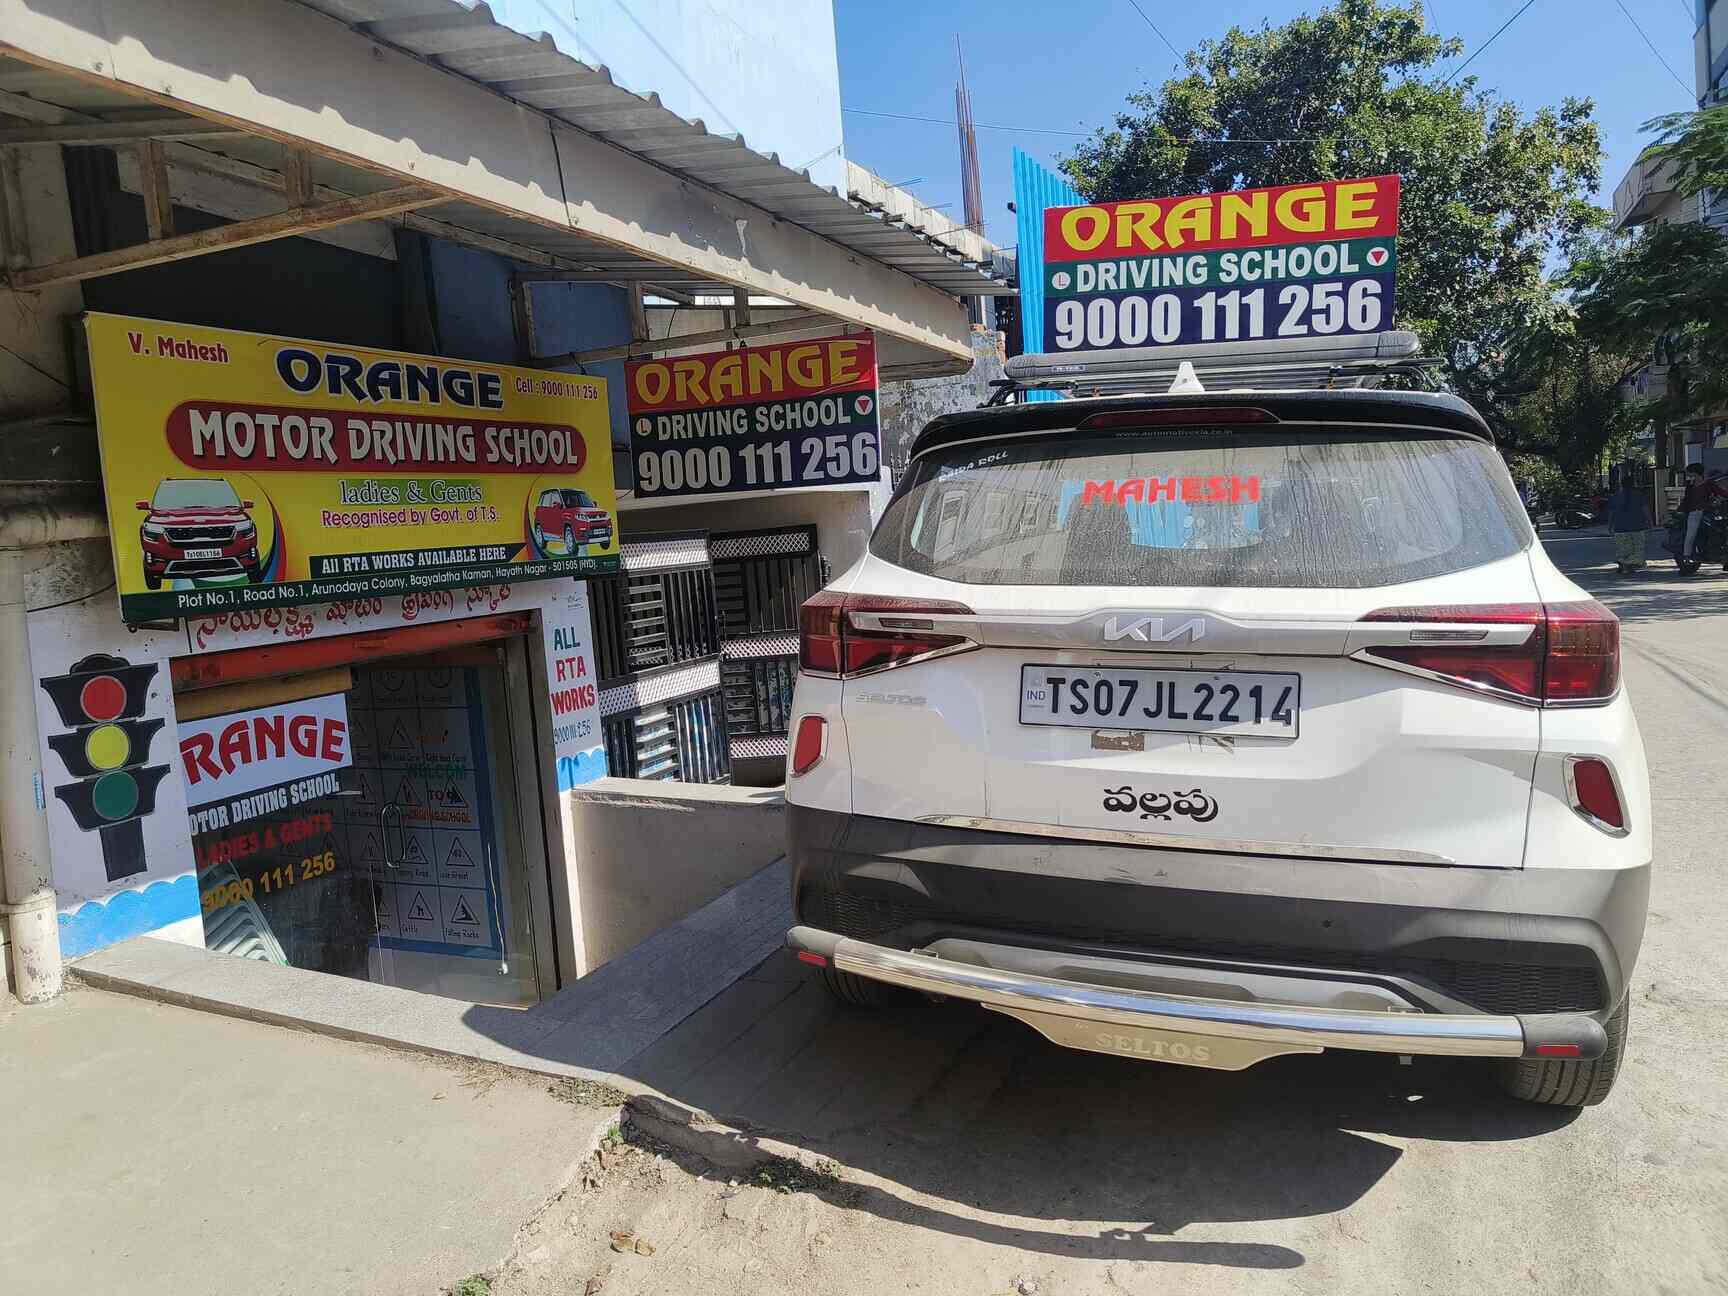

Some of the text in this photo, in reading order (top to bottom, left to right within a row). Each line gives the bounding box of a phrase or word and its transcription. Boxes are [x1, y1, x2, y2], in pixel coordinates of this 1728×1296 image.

[1061, 181, 1380, 251] ORANGE
[1076, 243, 1359, 293] DRIVING SCHOOL
[1055, 279, 1383, 349] 9000 111 256
[128, 332, 230, 363] V. Mahesh
[275, 348, 504, 409] ORANGE
[515, 377, 534, 393] Cell
[541, 380, 563, 396] 9000
[566, 383, 582, 398] 111
[583, 384, 598, 400] 256
[635, 341, 861, 405] ORANGE
[657, 397, 851, 441] DRIVING SCHOOL
[187, 409, 579, 467] MOTOR DRIVING SCHOOL
[638, 432, 878, 492] 9000 111 256
[340, 480, 482, 504] ladies & Gents
[1081, 475, 1262, 506] MAHESH
[321, 508, 407, 528] Recognised
[411, 508, 427, 525] by
[466, 507, 479, 521] of
[342, 556, 369, 572] RTA
[373, 552, 415, 570] WORKS
[418, 549, 476, 567] AVAILABLE
[479, 546, 507, 561] HERE
[178, 594, 203, 608] Plot
[243, 588, 276, 602] Road
[312, 581, 368, 596] Arunodaya
[371, 577, 408, 592] Colony,
[410, 572, 461, 587] Bagyalatha
[495, 566, 523, 580] Hayath
[523, 564, 547, 577] Nagar
[552, 561, 578, 573] 501505
[554, 626, 581, 651] ALL
[1104, 615, 1206, 642] KIA
[555, 655, 586, 682] RTA
[551, 683, 596, 716] WORKS
[1026, 690, 1045, 701] IND
[231, 787, 288, 823] DRIVING
[290, 773, 340, 805] SCHOOL
[1103, 785, 1219, 822] వల్లపు
[195, 832, 260, 868] LADIES
[260, 863, 295, 893] 111
[302, 851, 336, 881] 256
[1095, 1032, 1211, 1061] SELTOS
